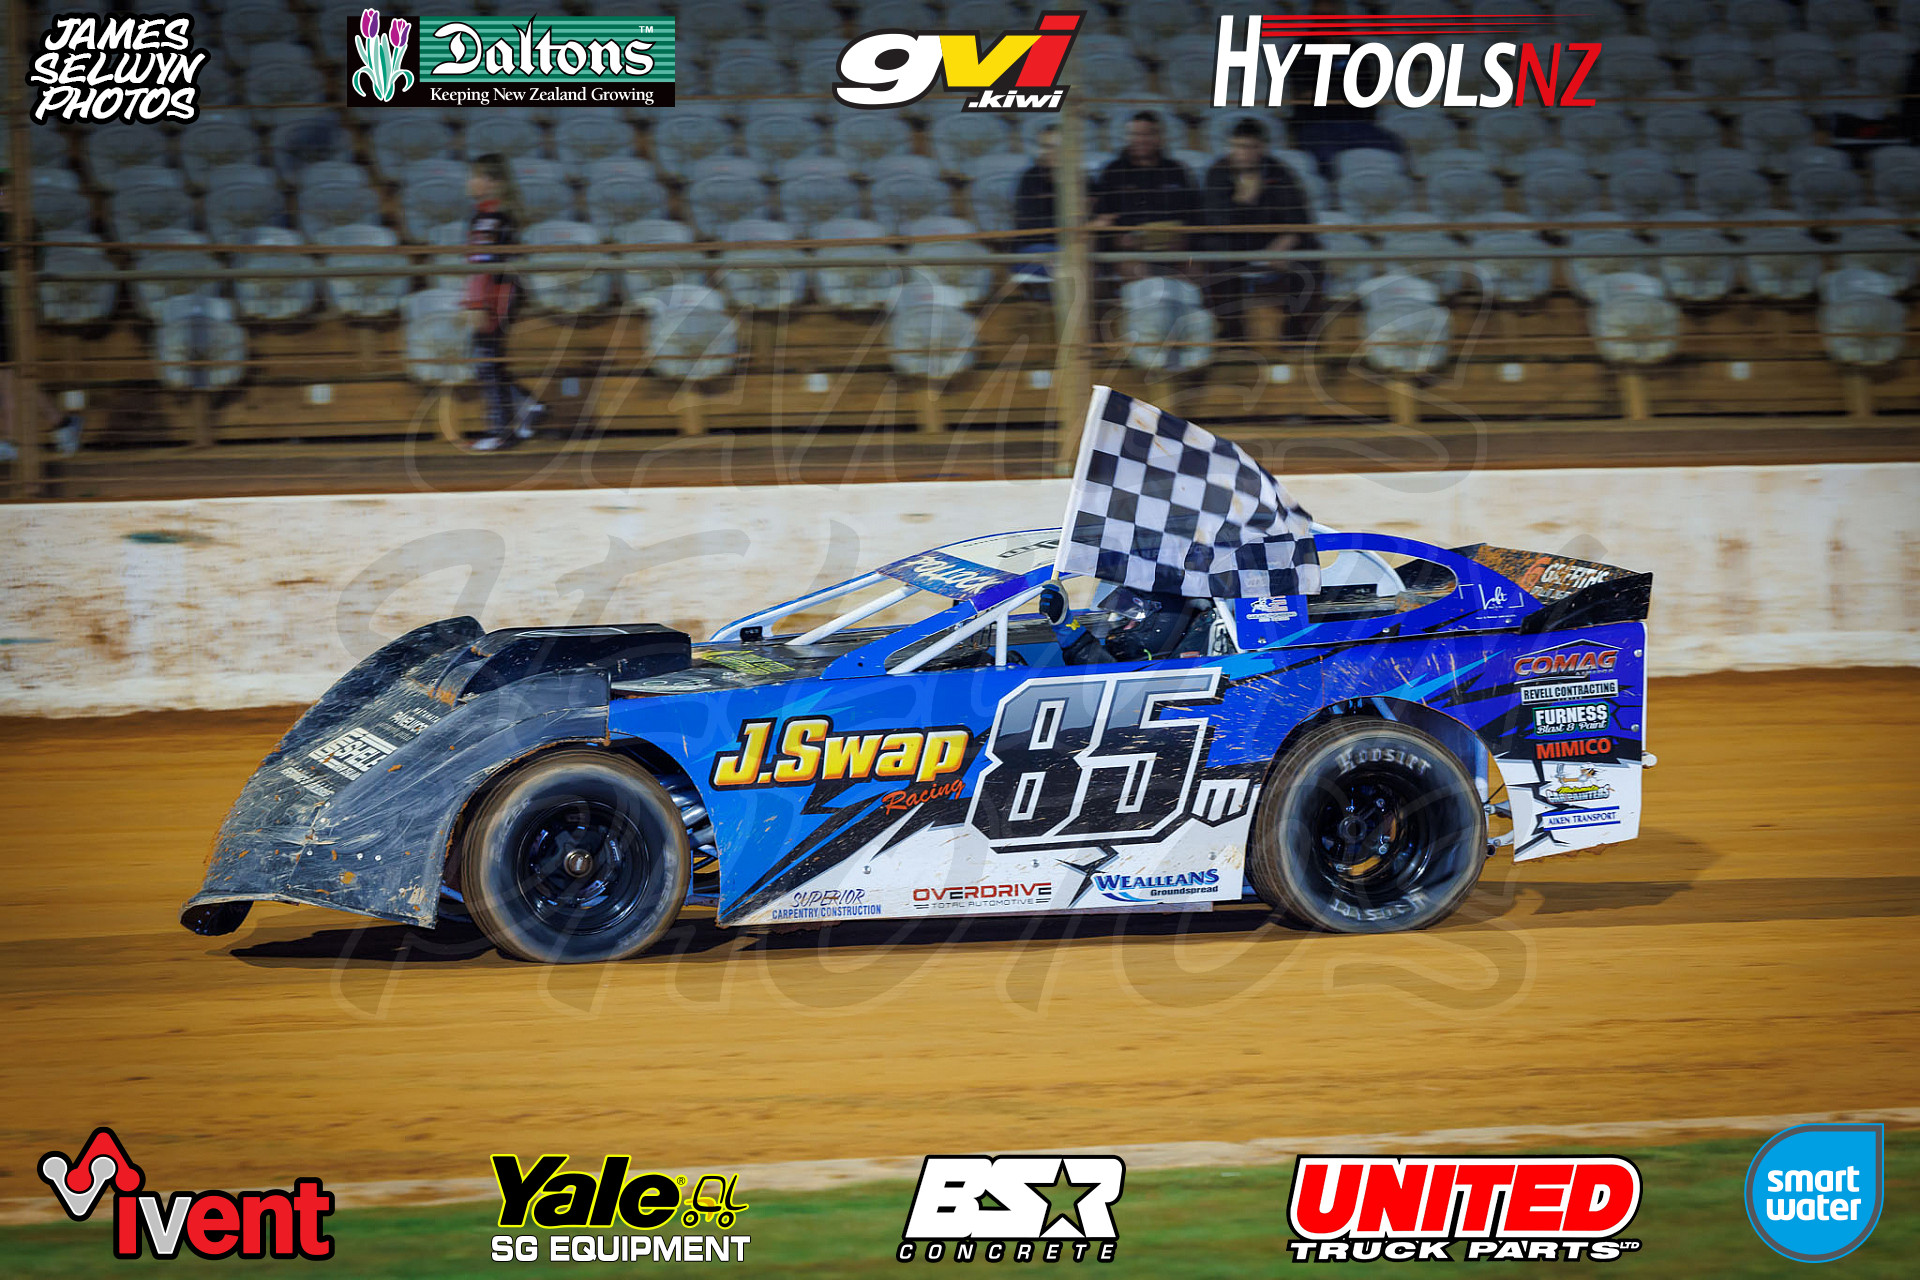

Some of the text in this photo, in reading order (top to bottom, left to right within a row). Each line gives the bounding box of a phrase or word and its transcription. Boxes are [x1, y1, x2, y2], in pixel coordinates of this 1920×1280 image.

[1513, 650, 1619, 676] COMAG
[1523, 682, 1616, 700] REVELL CONTRACTING
[1534, 704, 1609, 726] FURNESS
[1536, 724, 1565, 735] Blast
[1578, 720, 1607, 731] Paint
[714, 718, 970, 786] J.Swap
[1535, 738, 1612, 760] MIMICO
[881, 777, 966, 816] Racing
[1548, 811, 1617, 825] AIKEN TRANSPORT
[1095, 867, 1220, 892] WEALLEANS
[791, 888, 866, 908] SUPERIOR
[912, 882, 1052, 901] OVERDRIVE
[1150, 885, 1219, 898] Groundspread
[931, 897, 1034, 910] TOTAL AUTOMOTIVE
